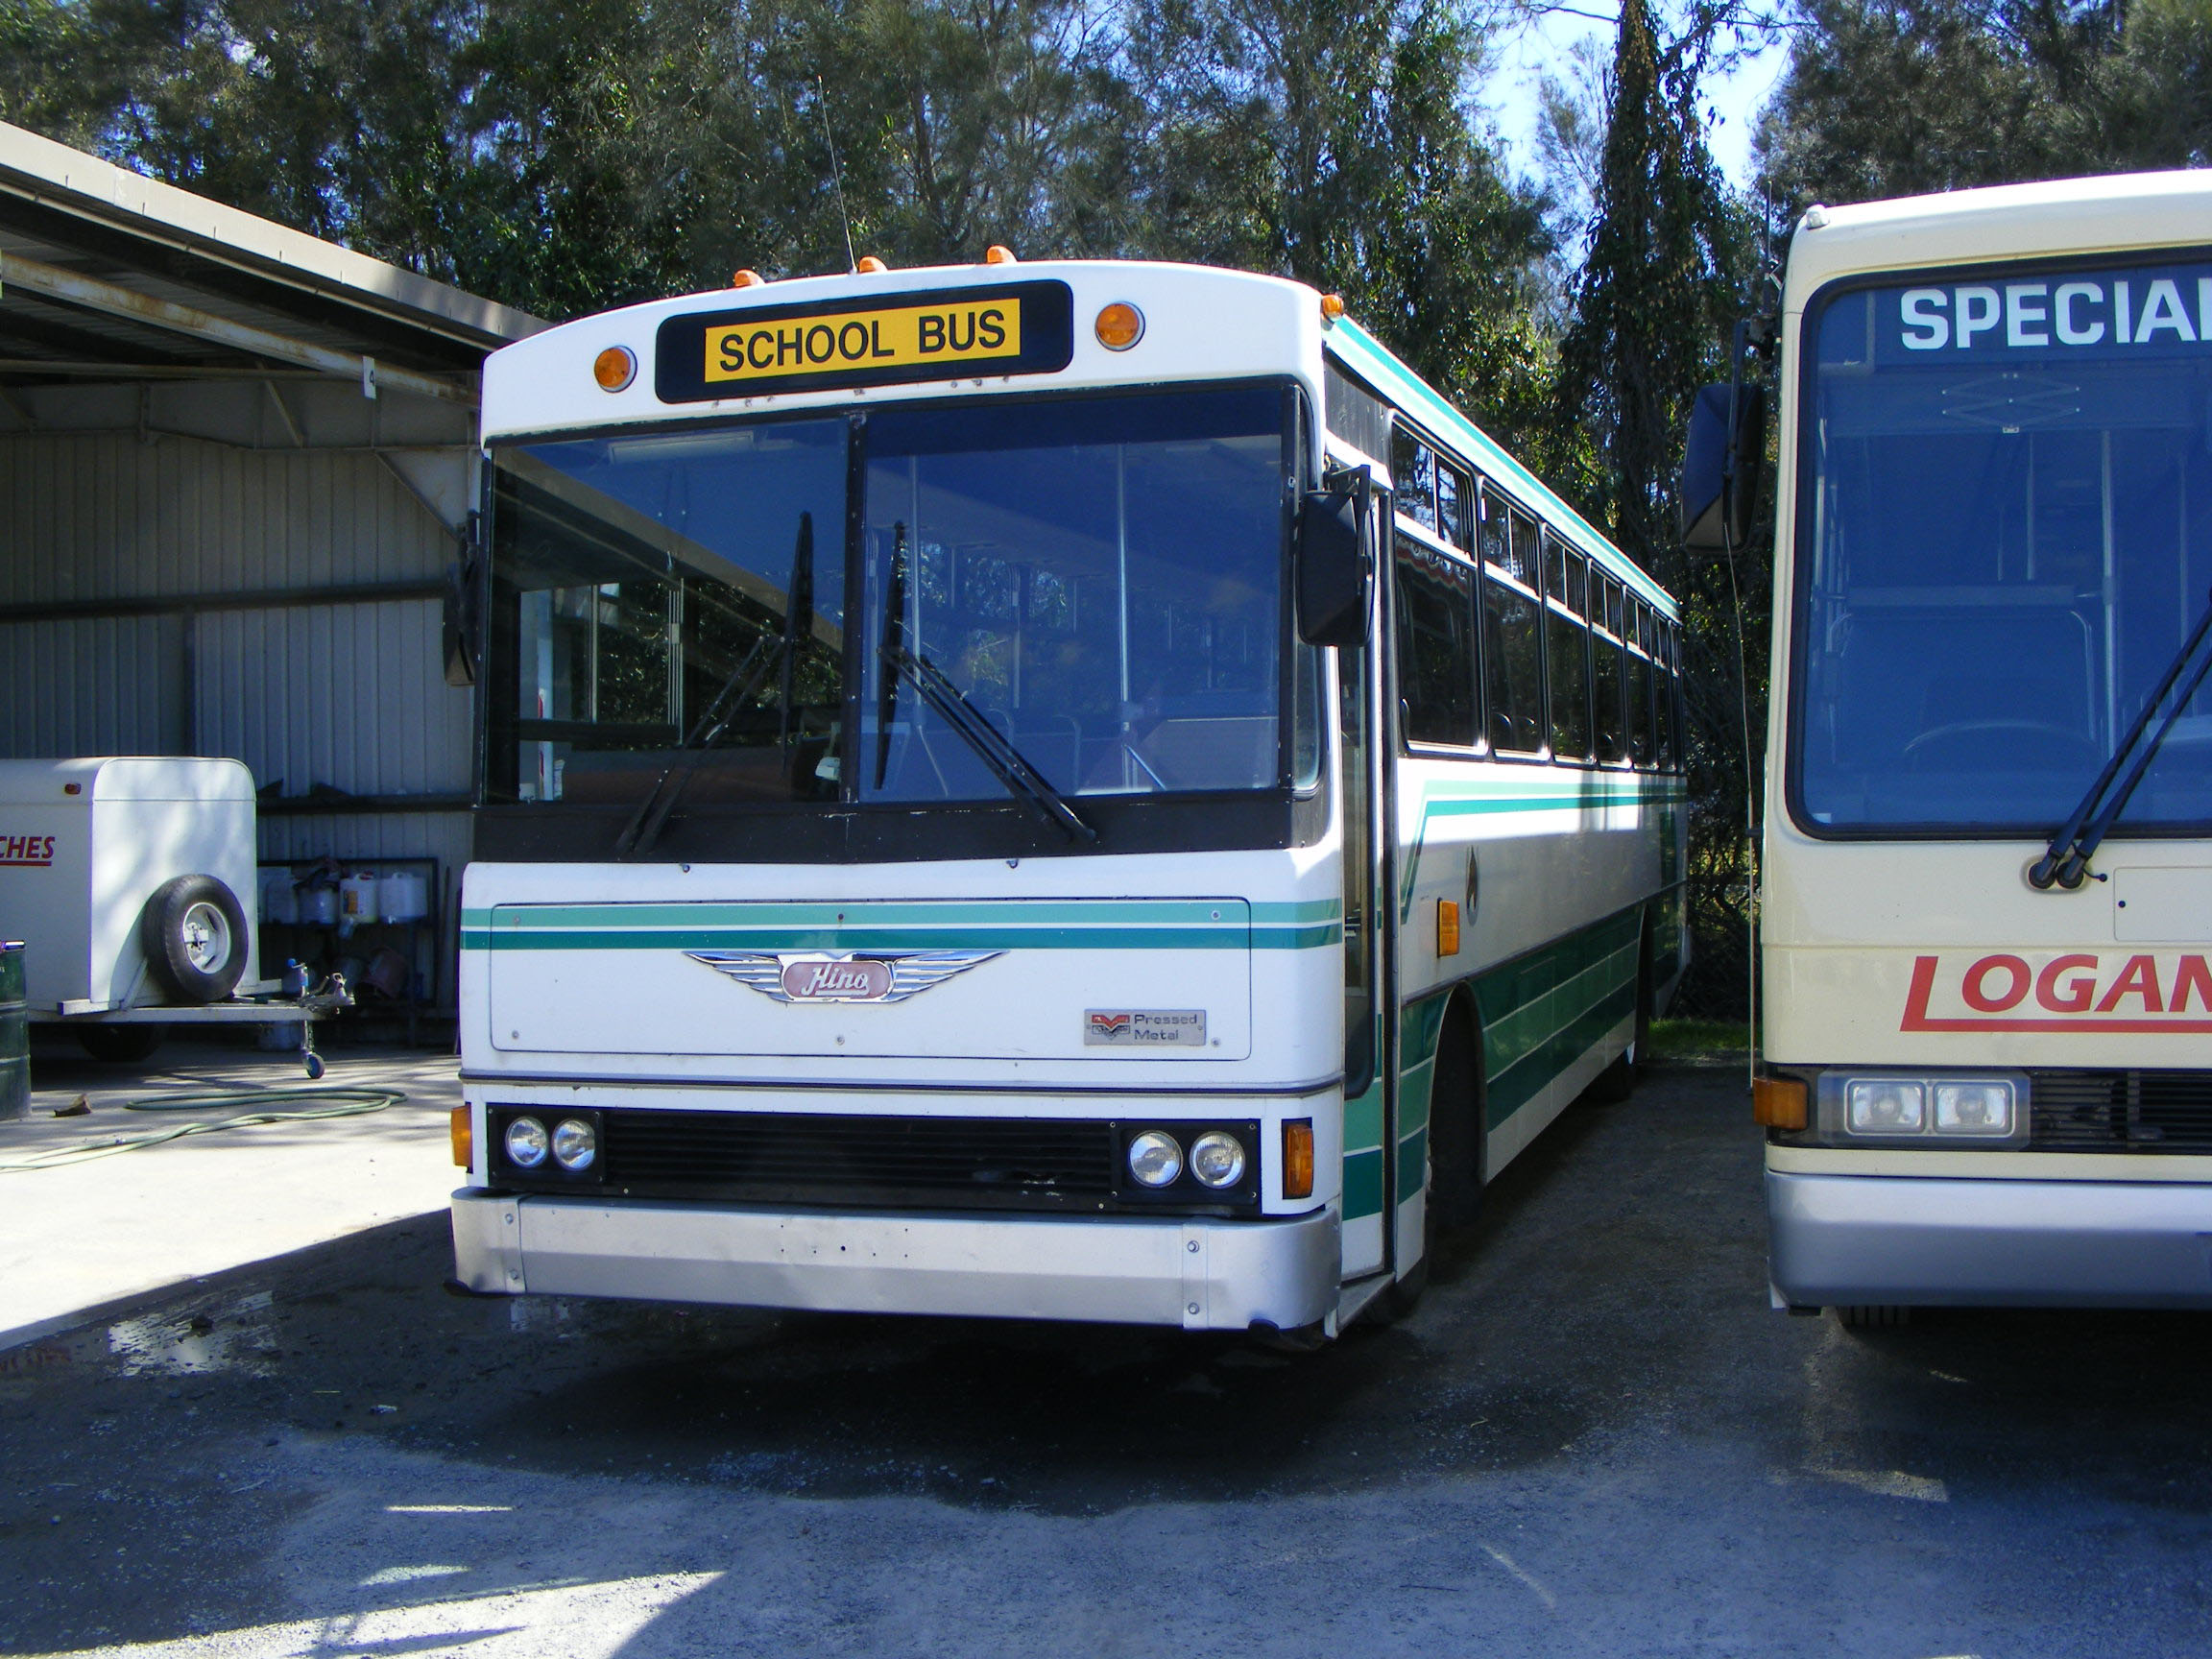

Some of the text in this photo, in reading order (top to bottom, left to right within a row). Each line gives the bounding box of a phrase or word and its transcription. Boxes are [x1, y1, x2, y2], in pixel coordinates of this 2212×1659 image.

[720, 310, 1005, 372] SCHOOL BUS
[801, 963, 870, 996] Hino
[1134, 1014, 1197, 1024] Pressed
[1134, 1029, 1179, 1040] Metal
